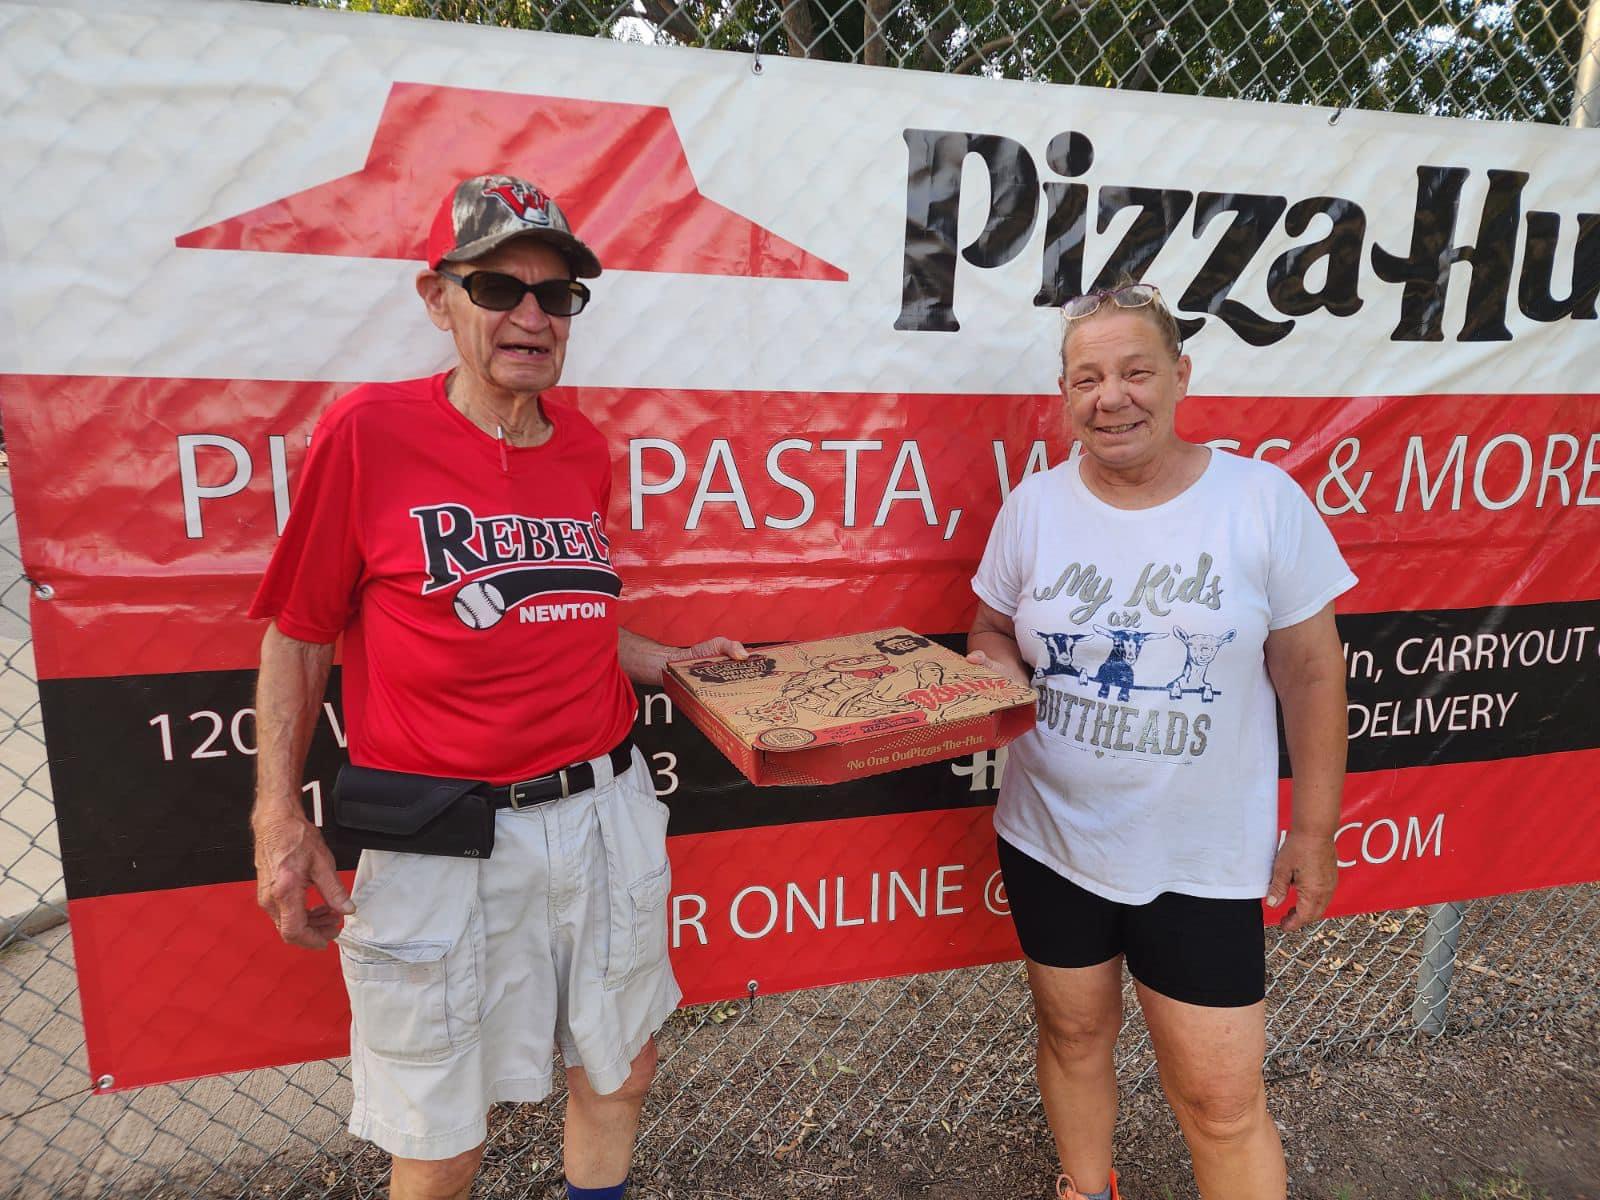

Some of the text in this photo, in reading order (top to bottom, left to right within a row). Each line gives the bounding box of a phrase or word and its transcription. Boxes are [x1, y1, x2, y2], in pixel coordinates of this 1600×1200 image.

[893, 128, 1599, 346] Pizza Hu
[628, 437, 963, 541] PASTA,
[1316, 433, 1600, 516] & MORE
[519, 602, 606, 623] NEWTON
[1033, 552, 1223, 625] My Kids
[1107, 611, 1142, 628] are
[1396, 627, 1595, 676] CARRYOUT
[149, 708, 259, 761] 120
[1036, 684, 1212, 758] BUTTHEADS
[1347, 691, 1519, 740] DELIVERY
[847, 759, 865, 771] No
[867, 756, 890, 767] One
[730, 864, 965, 940] ONLINE
